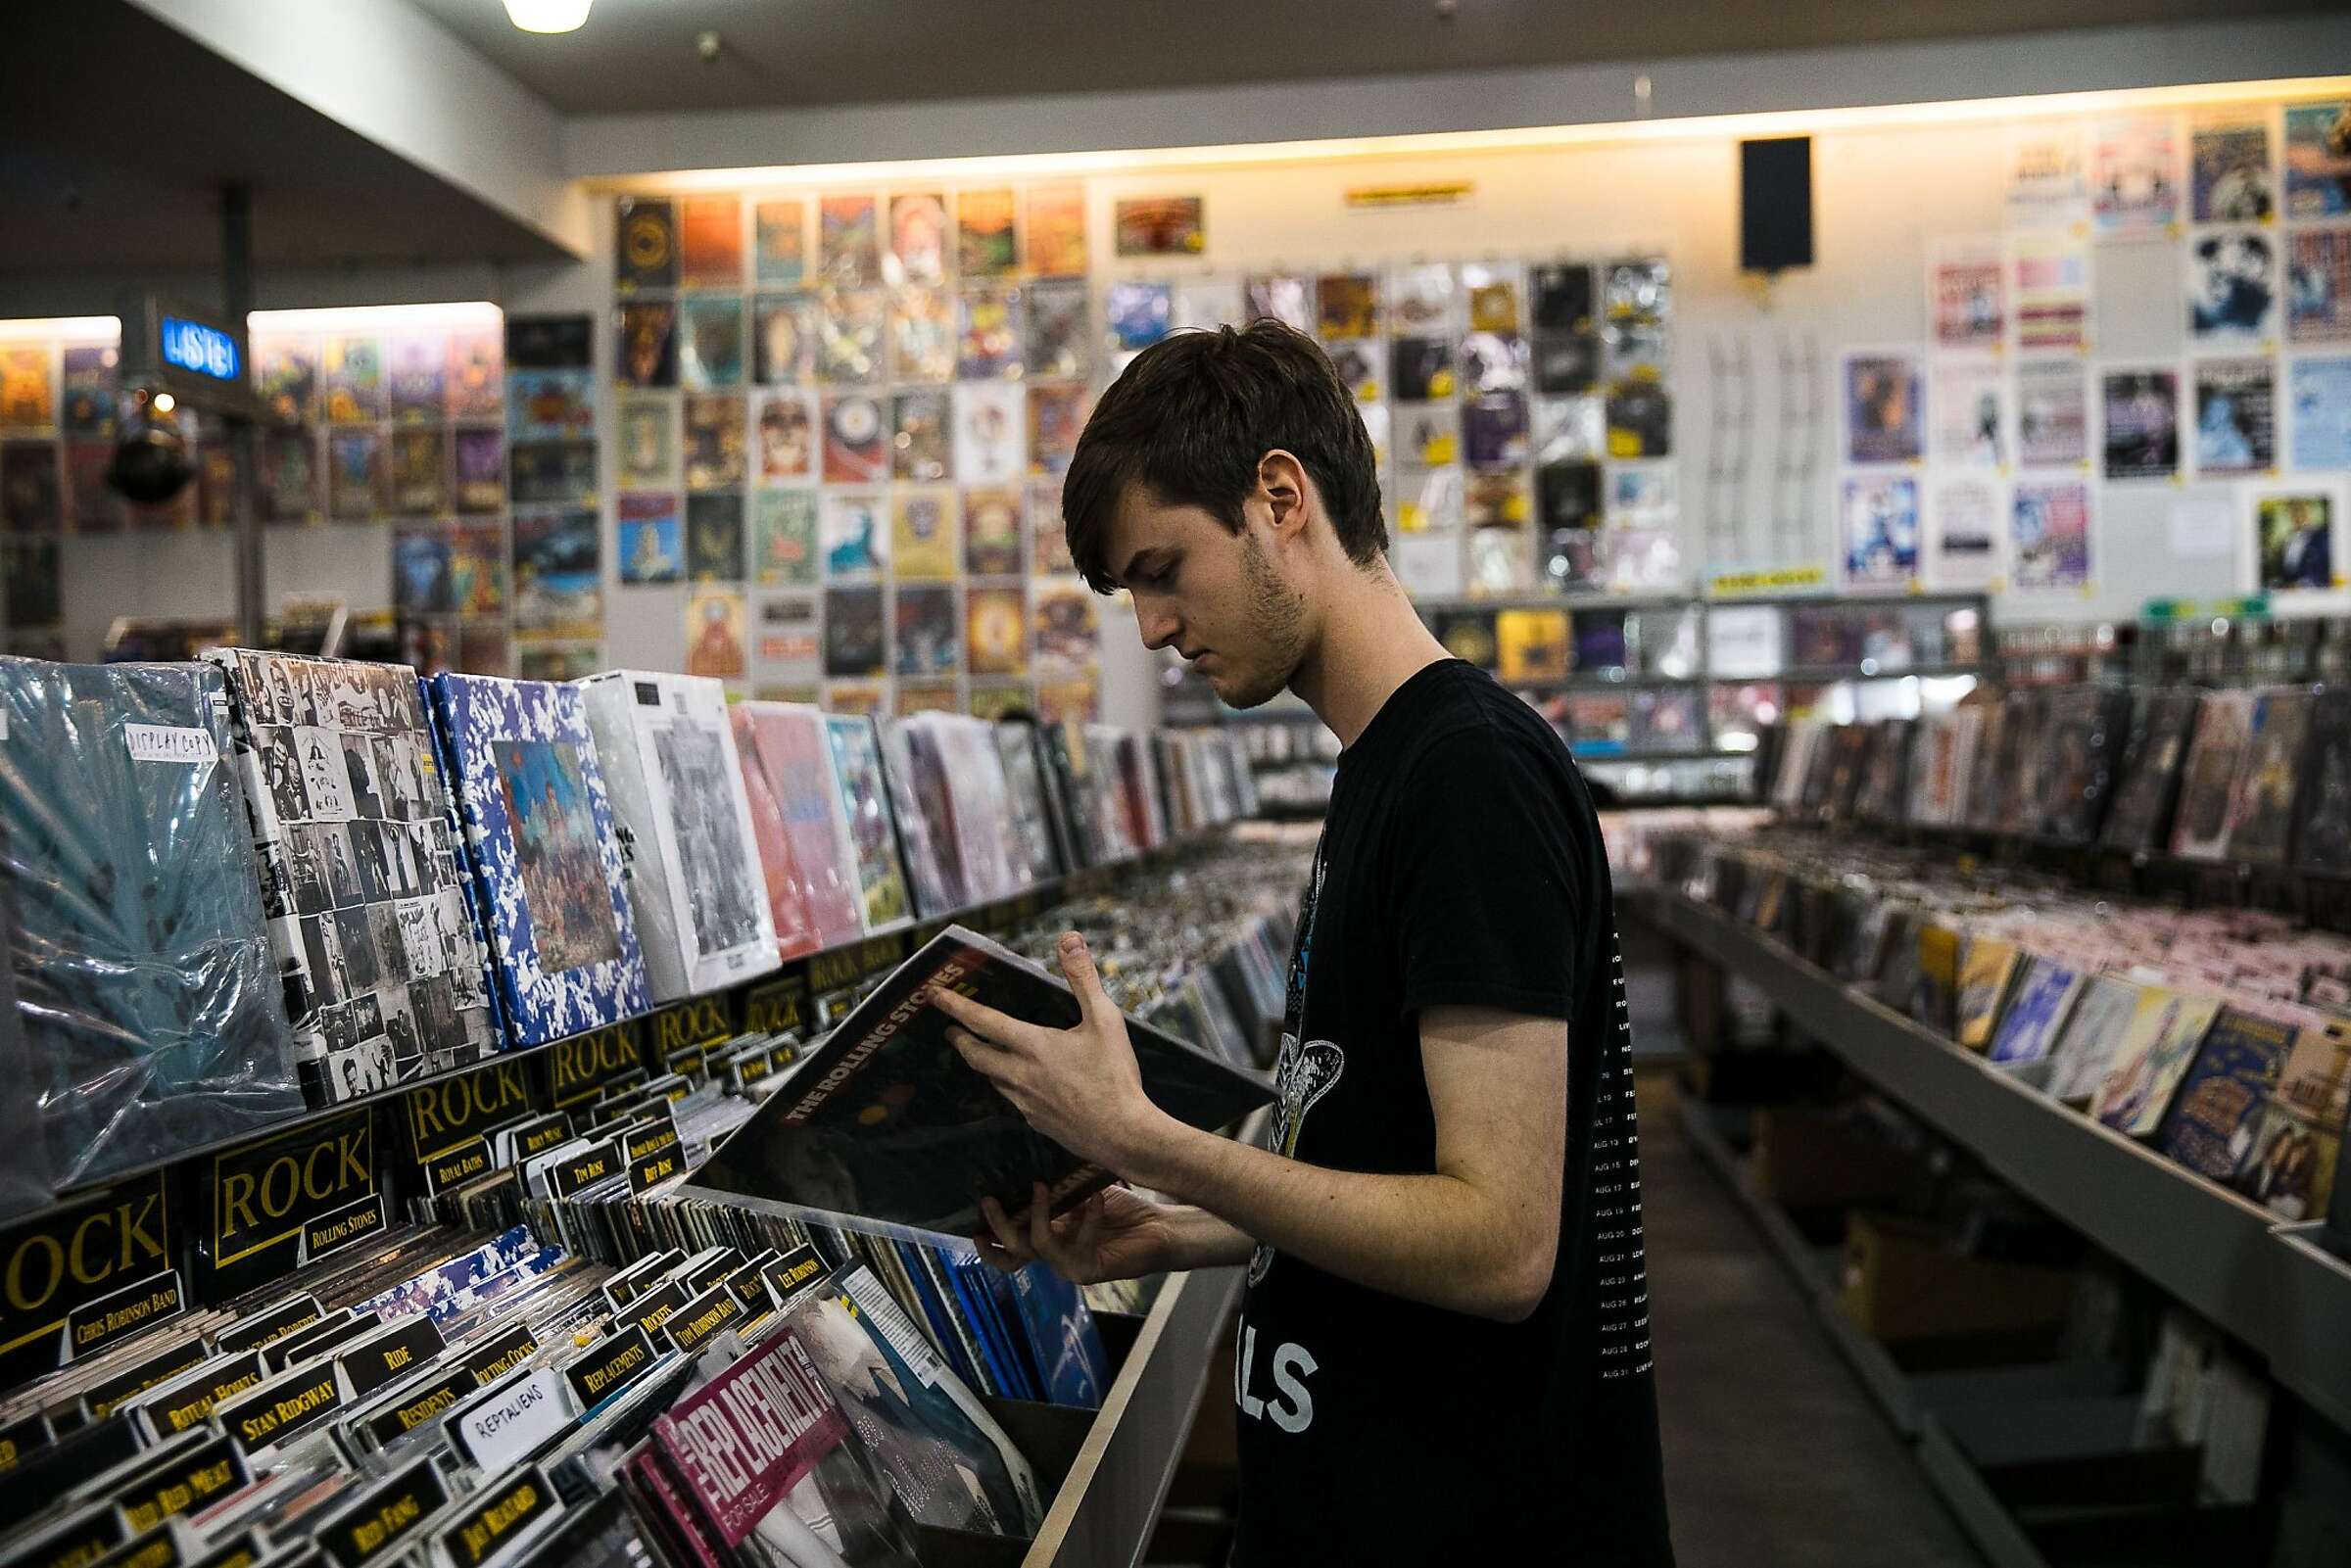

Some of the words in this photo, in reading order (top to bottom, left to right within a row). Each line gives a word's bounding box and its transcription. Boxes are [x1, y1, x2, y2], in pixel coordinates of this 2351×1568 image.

[128, 732, 177, 756] DISPLAY
[555, 1026, 640, 1088] ROCK
[785, 1090, 826, 1121] THE
[823, 1023, 897, 1091] ROLLING
[415, 1057, 527, 1140] ROCK
[221, 1127, 371, 1238] ROCK
[440, 1159, 463, 1184] ROYAL
[0, 1194, 165, 1316] OCK
[312, 1218, 348, 1249] ROLLING
[347, 1209, 378, 1238] STONES
[78, 1318, 106, 1345] CHRIS
[106, 1299, 152, 1332] ROBINSON
[152, 1289, 177, 1312] BAND
[641, 1304, 674, 1334] ROCKETS
[676, 1327, 693, 1347] TOM
[690, 1307, 723, 1341] ROBINSON
[715, 1298, 737, 1318] BAND
[383, 1345, 412, 1371] RIDE
[583, 1343, 646, 1395] REPLACEMENTS
[1235, 1312, 1319, 1433] LS
[242, 1410, 278, 1442] STAN
[275, 1379, 337, 1423] RIDGWAY
[397, 1386, 456, 1430] RESIDENTS
[475, 1384, 544, 1439] REPTALIENS
[679, 1335, 836, 1504] REPLACEMENTS
[722, 1503, 744, 1534] FOR
[742, 1482, 770, 1514] SALE
